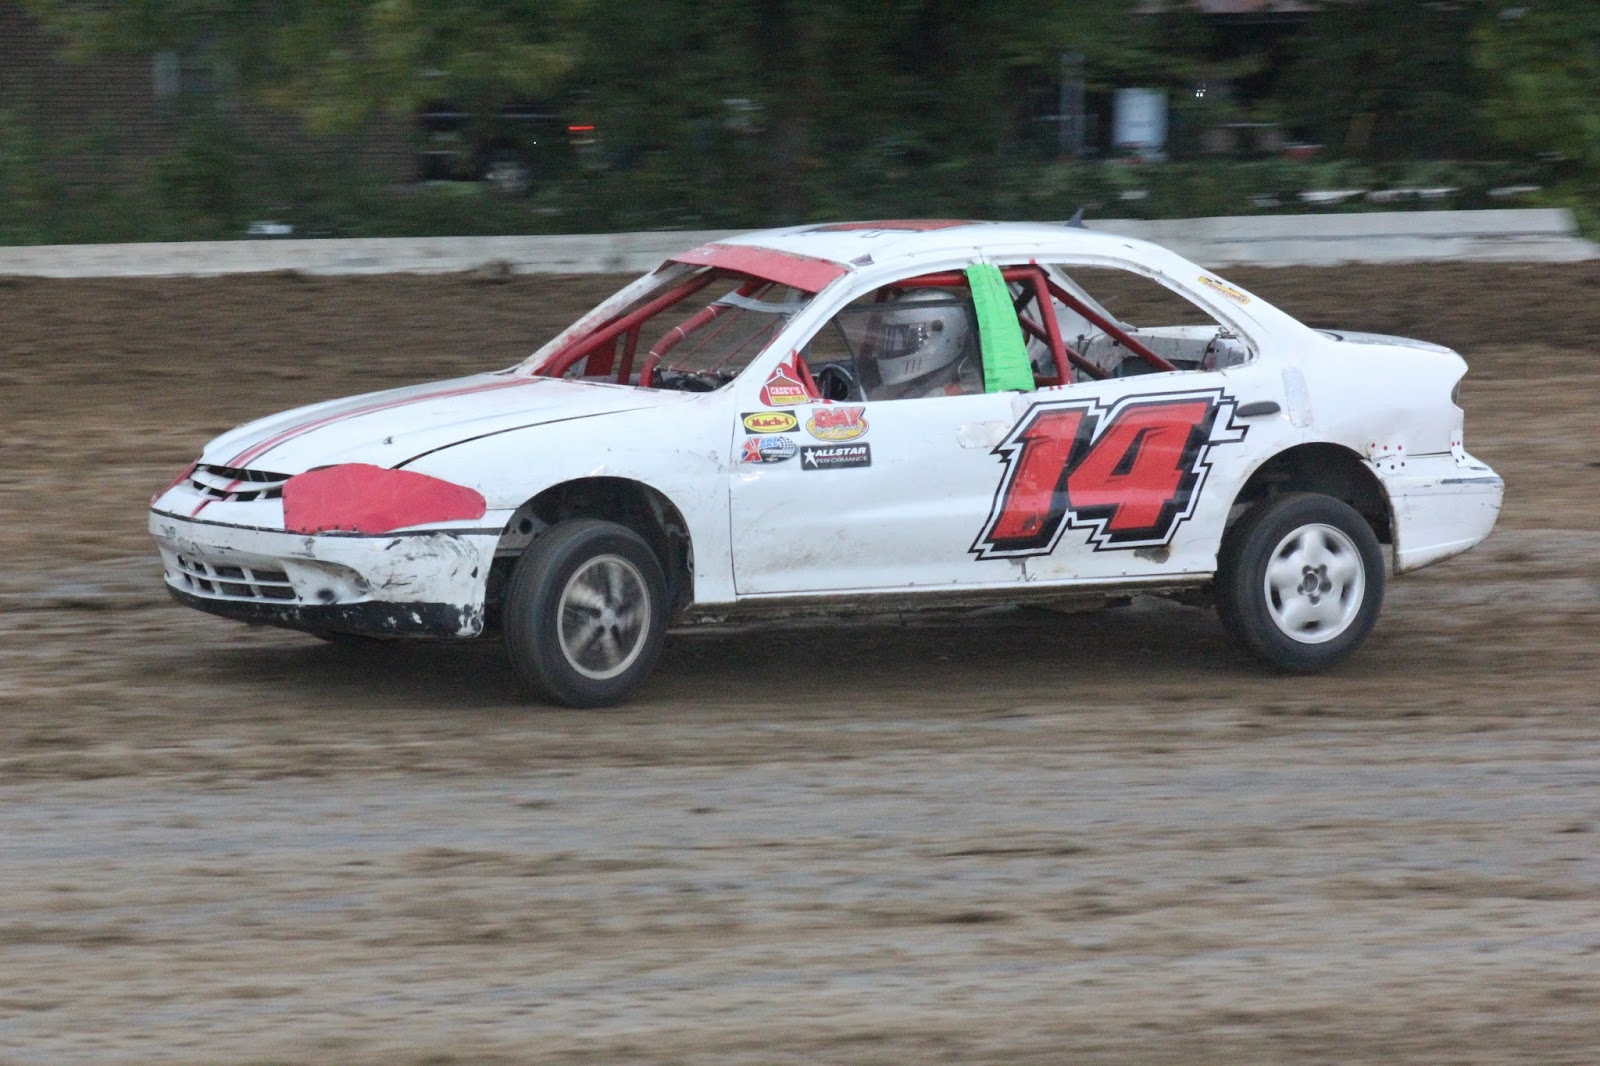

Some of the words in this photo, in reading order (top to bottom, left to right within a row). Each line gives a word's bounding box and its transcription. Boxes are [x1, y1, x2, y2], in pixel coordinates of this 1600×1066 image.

[770, 386, 801, 395] CASEY'S
[812, 407, 864, 428] DAY
[815, 447, 867, 457] ALLSTAR
[816, 456, 868, 464] PERFORMANCE
[983, 398, 1216, 546] 14
